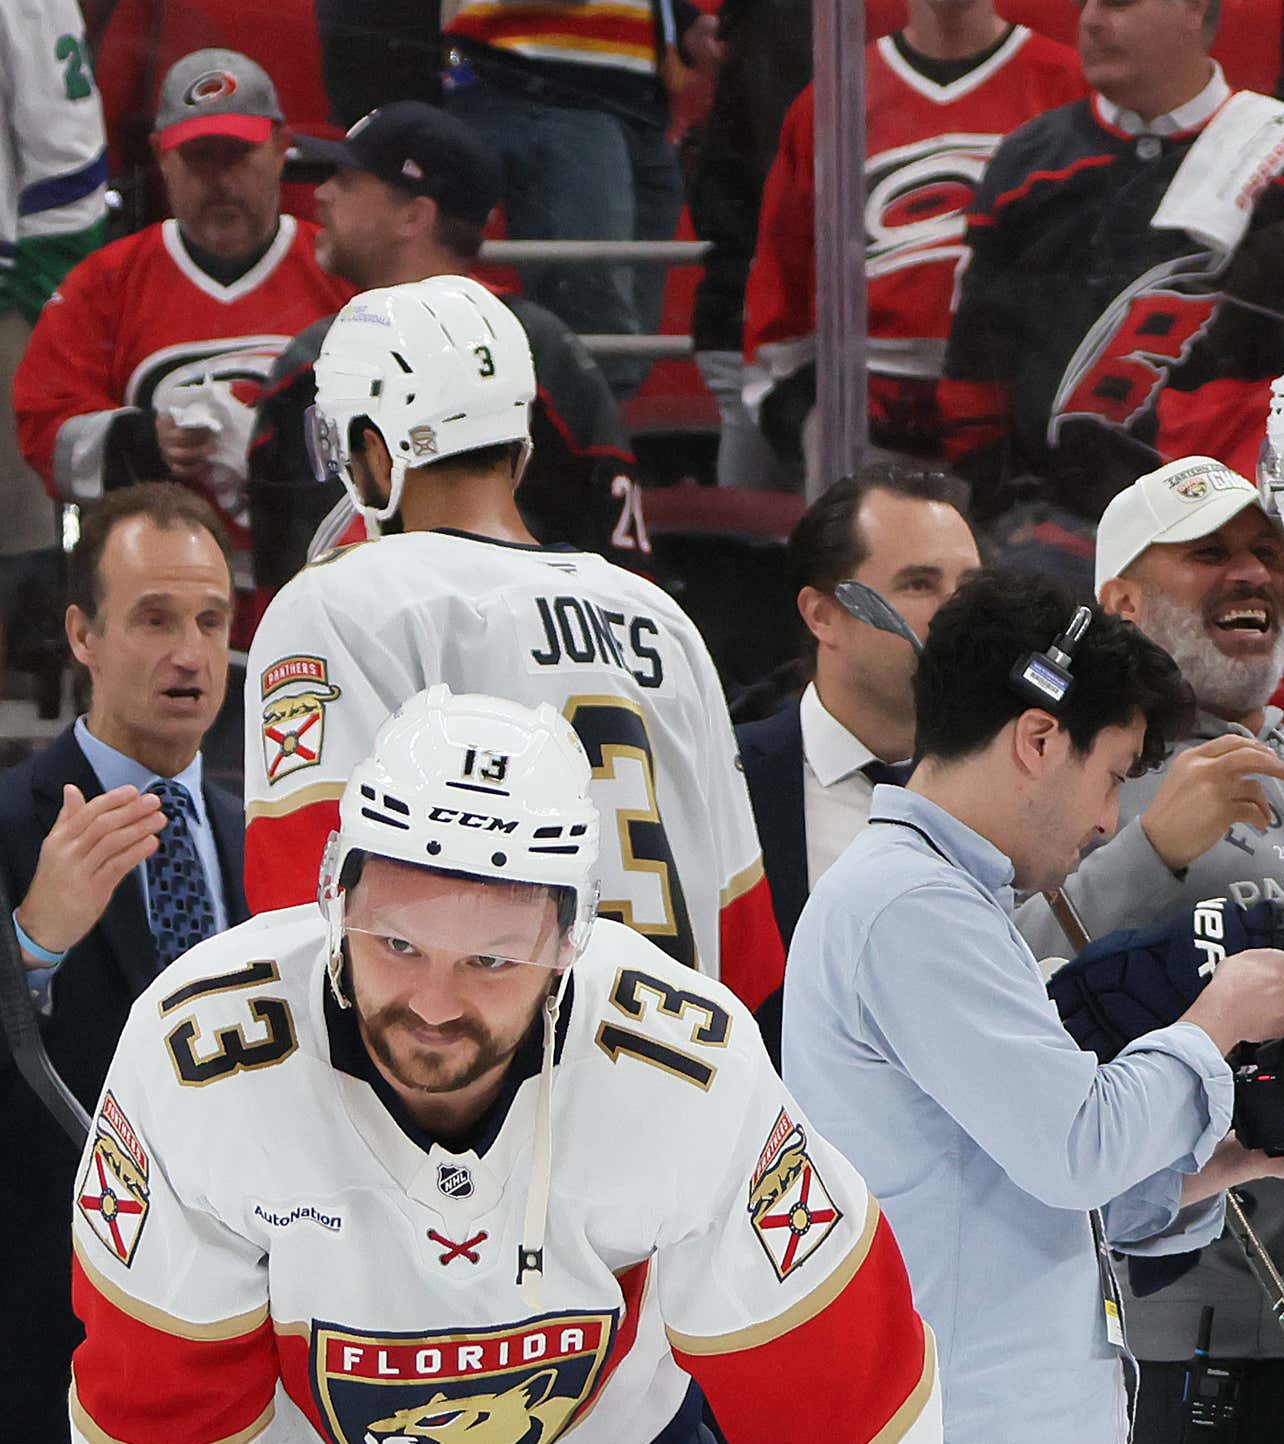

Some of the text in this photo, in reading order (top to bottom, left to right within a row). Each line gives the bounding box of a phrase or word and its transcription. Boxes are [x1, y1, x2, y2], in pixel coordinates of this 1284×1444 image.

[474, 345, 495, 378] 3
[531, 596, 664, 688] JONES
[268, 661, 317, 686] PANTHERS
[461, 745, 511, 783] 13
[428, 806, 520, 835] CCM
[158, 959, 300, 1088] 13
[594, 966, 734, 1093] 13
[443, 1171, 468, 1192] NHL
[255, 1205, 342, 1229] AutoNation
[343, 1328, 585, 1375] FLORIDA
